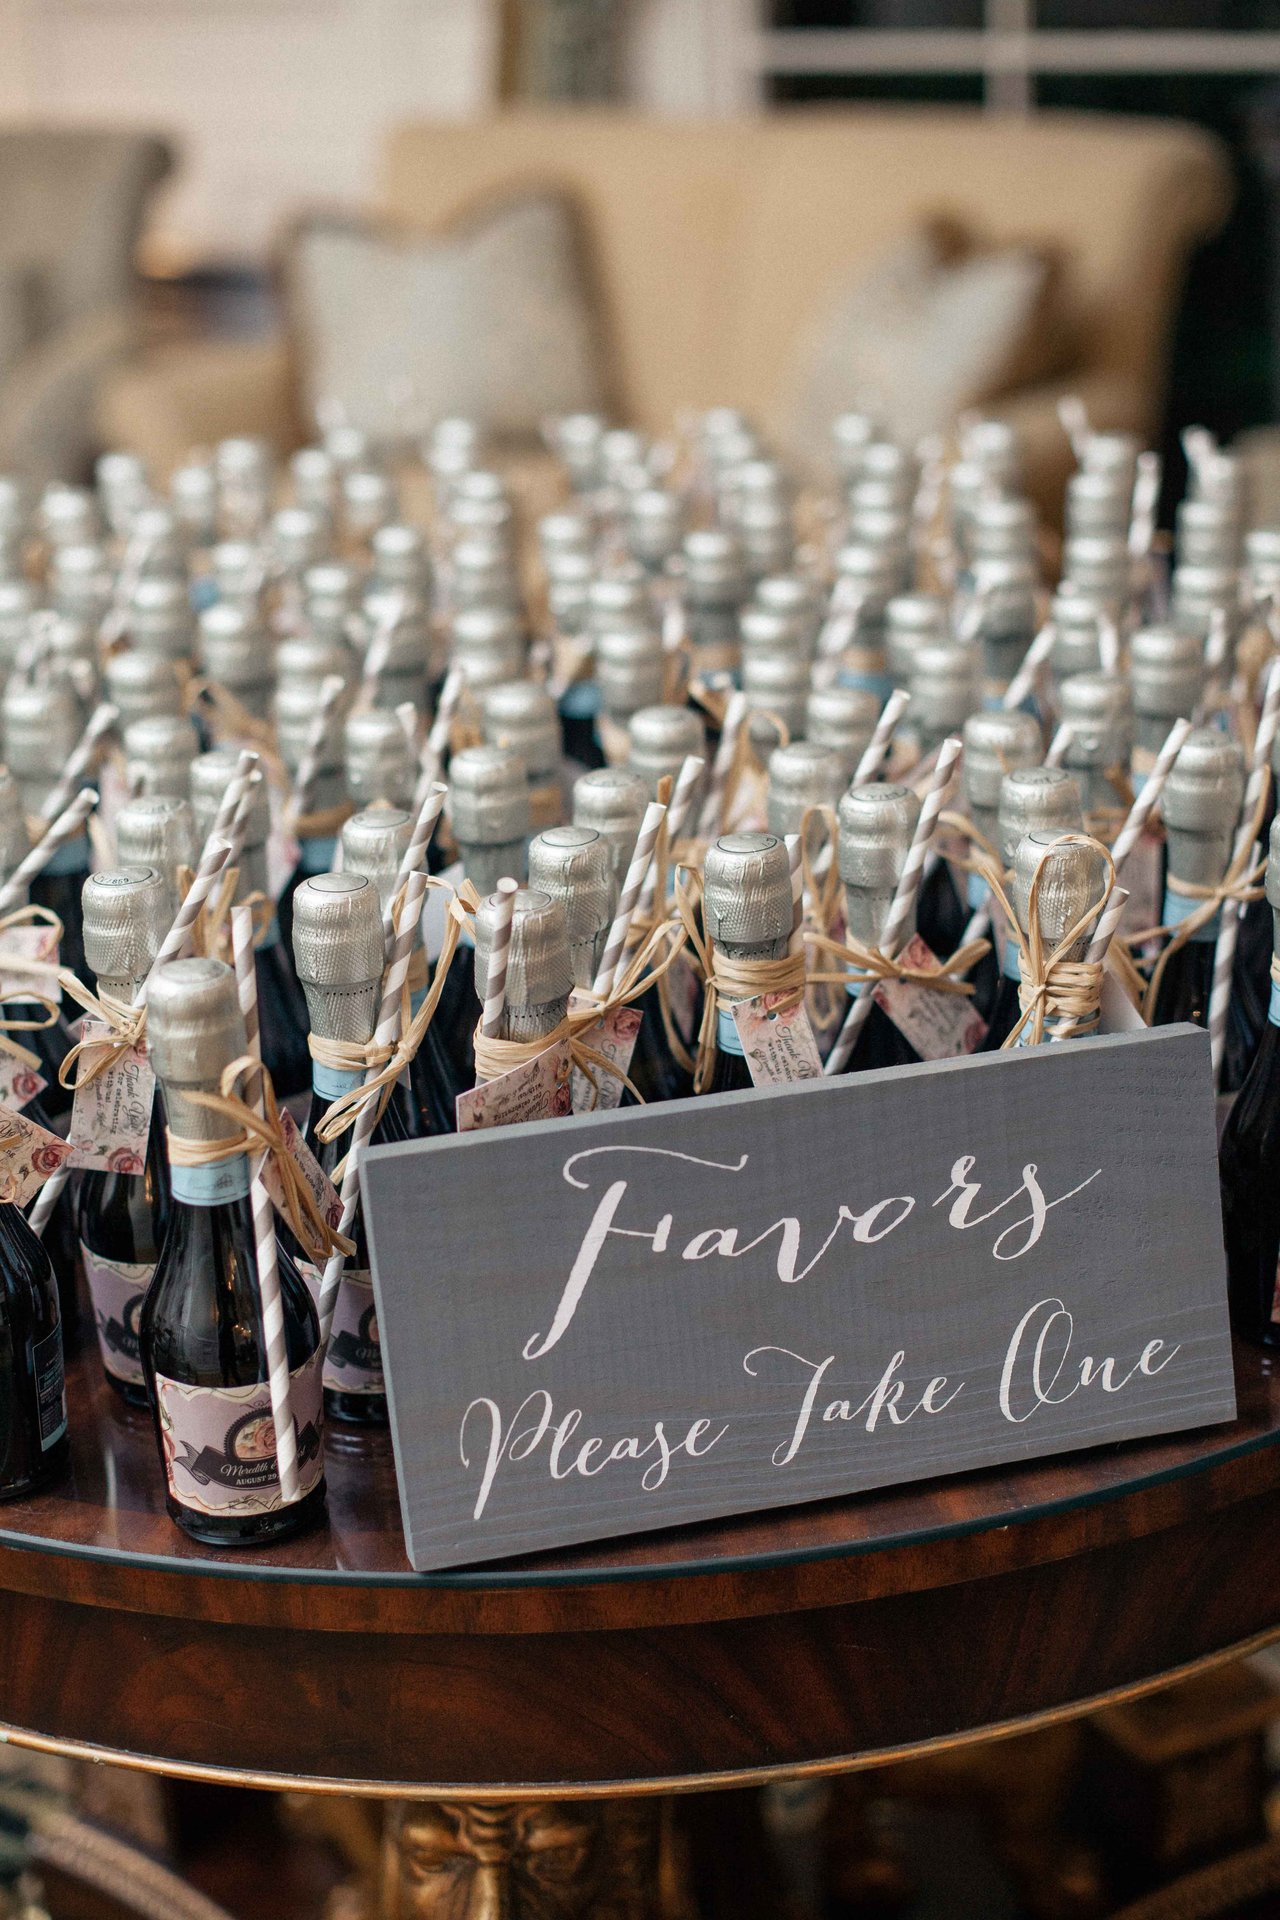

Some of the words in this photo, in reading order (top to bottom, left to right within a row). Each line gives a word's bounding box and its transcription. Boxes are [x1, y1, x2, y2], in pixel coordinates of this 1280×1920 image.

[768, 1041, 778, 1062] with
[775, 1024, 800, 1060] Thank
[775, 1039, 783, 1052] for
[105, 1070, 114, 1092] with
[115, 1071, 125, 1086] for
[123, 1060, 140, 1098] Thank
[532, 1091, 543, 1102] for
[110, 1087, 122, 1135] celebrating
[493, 1098, 531, 1121] celebrating
[523, 1145, 1101, 1360] Favors
[460, 1389, 729, 1521] Please
[743, 1345, 965, 1467] Take
[999, 1298, 1181, 1423] One
[220, 1462, 268, 1477] Meredith
[235, 1475, 267, 1486] AUGUST
